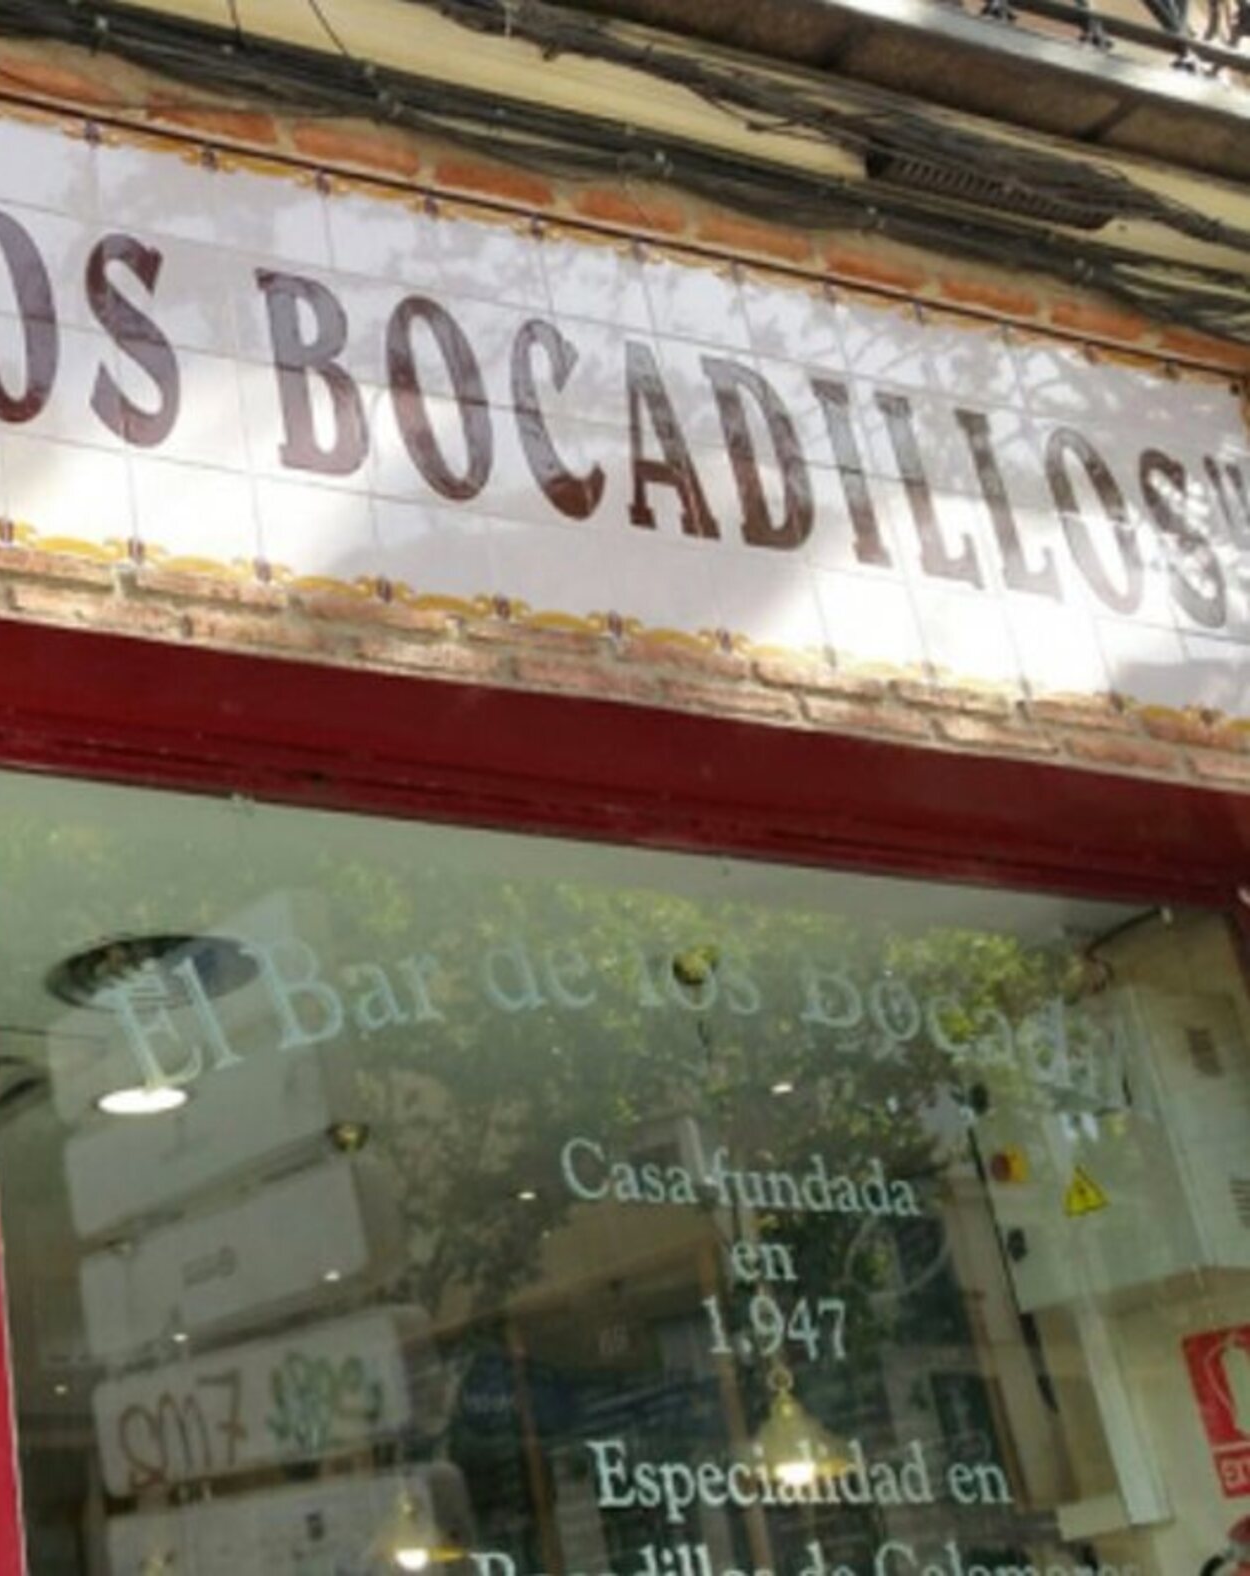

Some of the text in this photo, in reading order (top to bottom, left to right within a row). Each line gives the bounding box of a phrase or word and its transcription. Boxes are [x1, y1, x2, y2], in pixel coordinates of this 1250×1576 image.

[93, 955, 246, 1088] El
[238, 935, 448, 1051] Bar
[485, 932, 598, 1012] de
[560, 1137, 922, 1217] Casa fundada
[729, 1239, 798, 1282] en
[701, 1294, 848, 1361] 1.947
[586, 1438, 1014, 1524] Especialidad en
